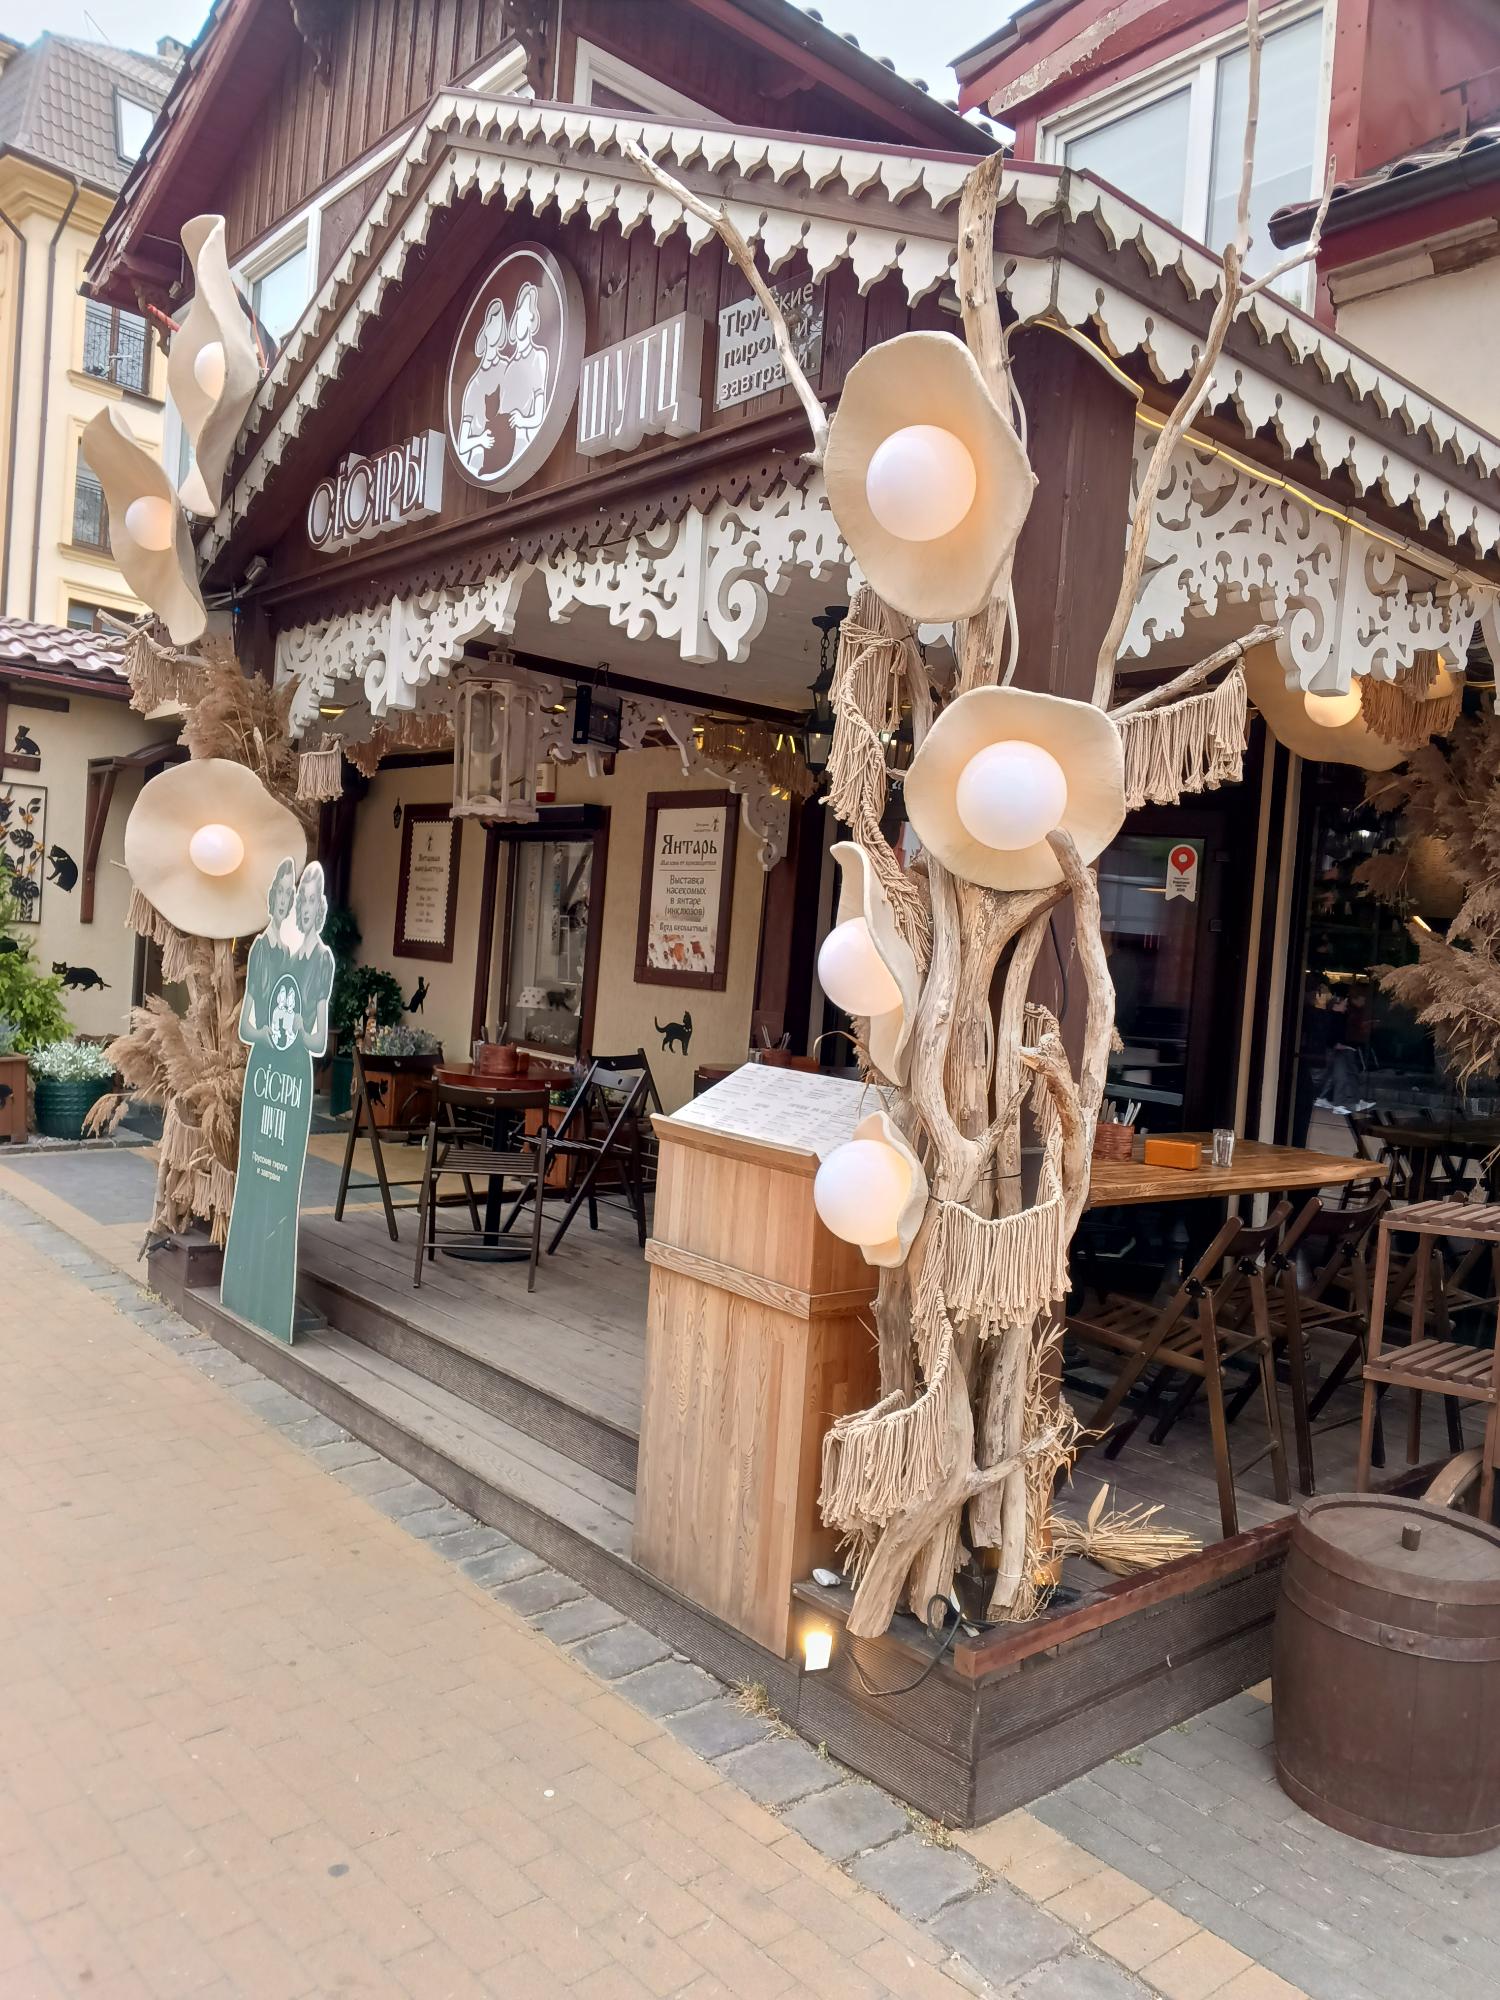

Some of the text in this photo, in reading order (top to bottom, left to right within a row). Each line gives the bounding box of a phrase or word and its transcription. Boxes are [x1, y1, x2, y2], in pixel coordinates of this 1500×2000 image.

[578, 320, 682, 444] ШУТЦ
[718, 349, 817, 401] завтраи.
[305, 432, 430, 550] СЁСТРЫ
[660, 833, 718, 861] Янтарь
[665, 886, 707, 896] насекомых
[669, 873, 705, 885] Выставка
[664, 905, 705, 917] (инклюзов)
[670, 896, 702, 908] в янтаре
[260, 1104, 287, 1147] ШУТЦ
